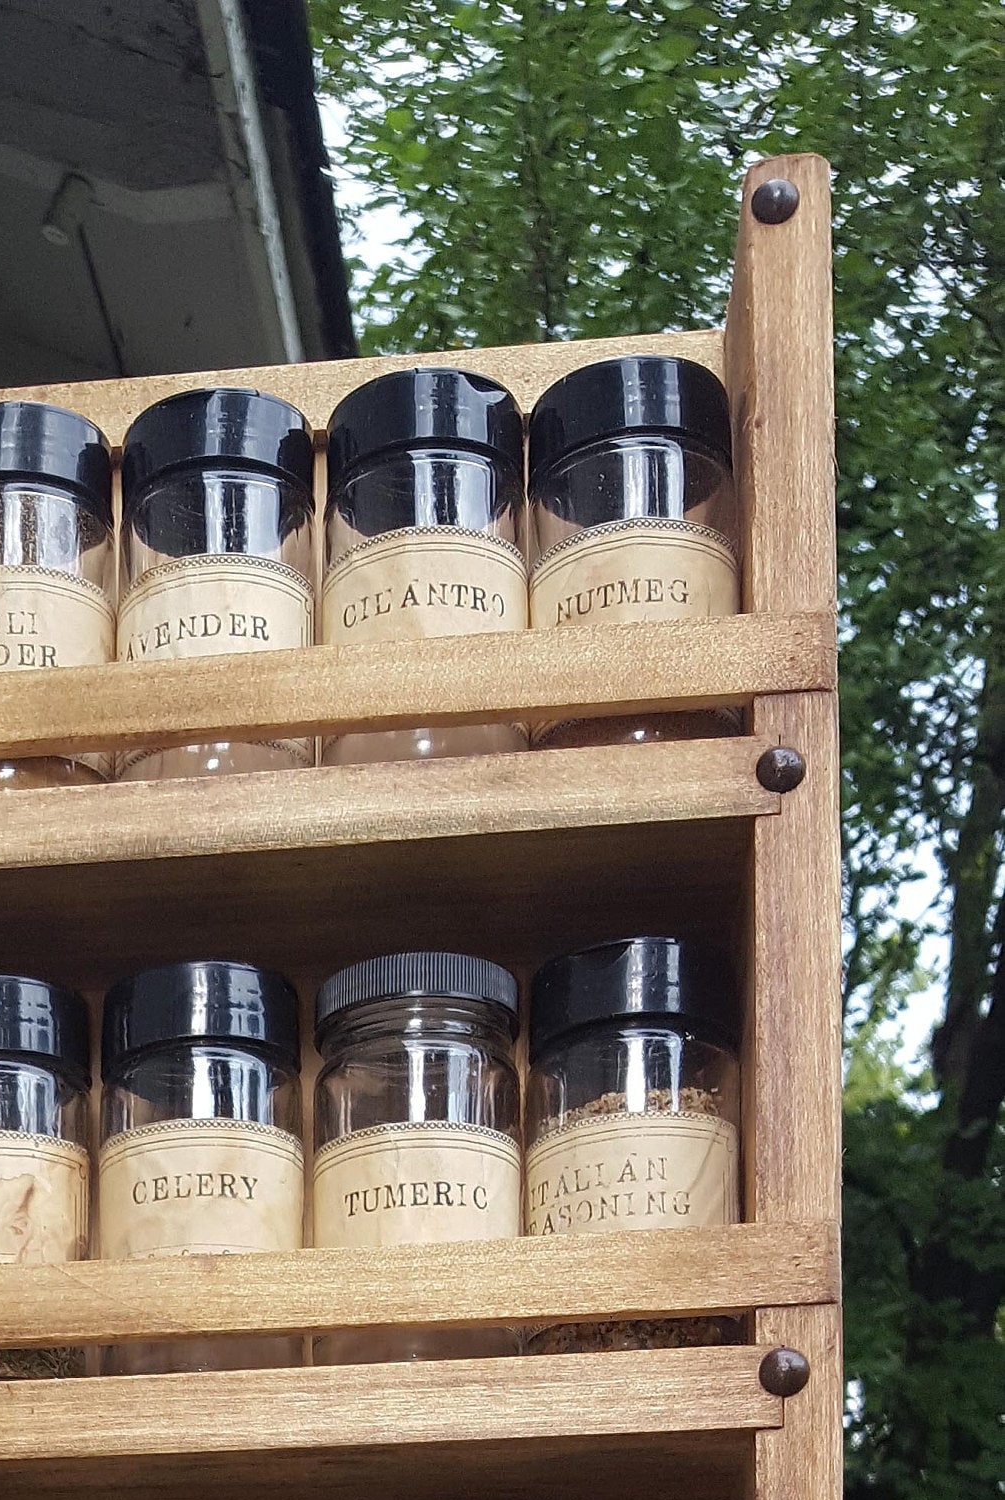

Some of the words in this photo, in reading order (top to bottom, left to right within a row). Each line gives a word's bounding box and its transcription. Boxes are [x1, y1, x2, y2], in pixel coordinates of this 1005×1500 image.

[342, 579, 506, 628] CILANTRO
[555, 578, 691, 625] NUTMEG
[120, 613, 270, 662] AVENDER
[131, 1172, 259, 1205] CELERY
[344, 1181, 489, 1217] TUMERIC
[529, 1153, 669, 1211] ITALIAN
[528, 1190, 691, 1236] EASONING
